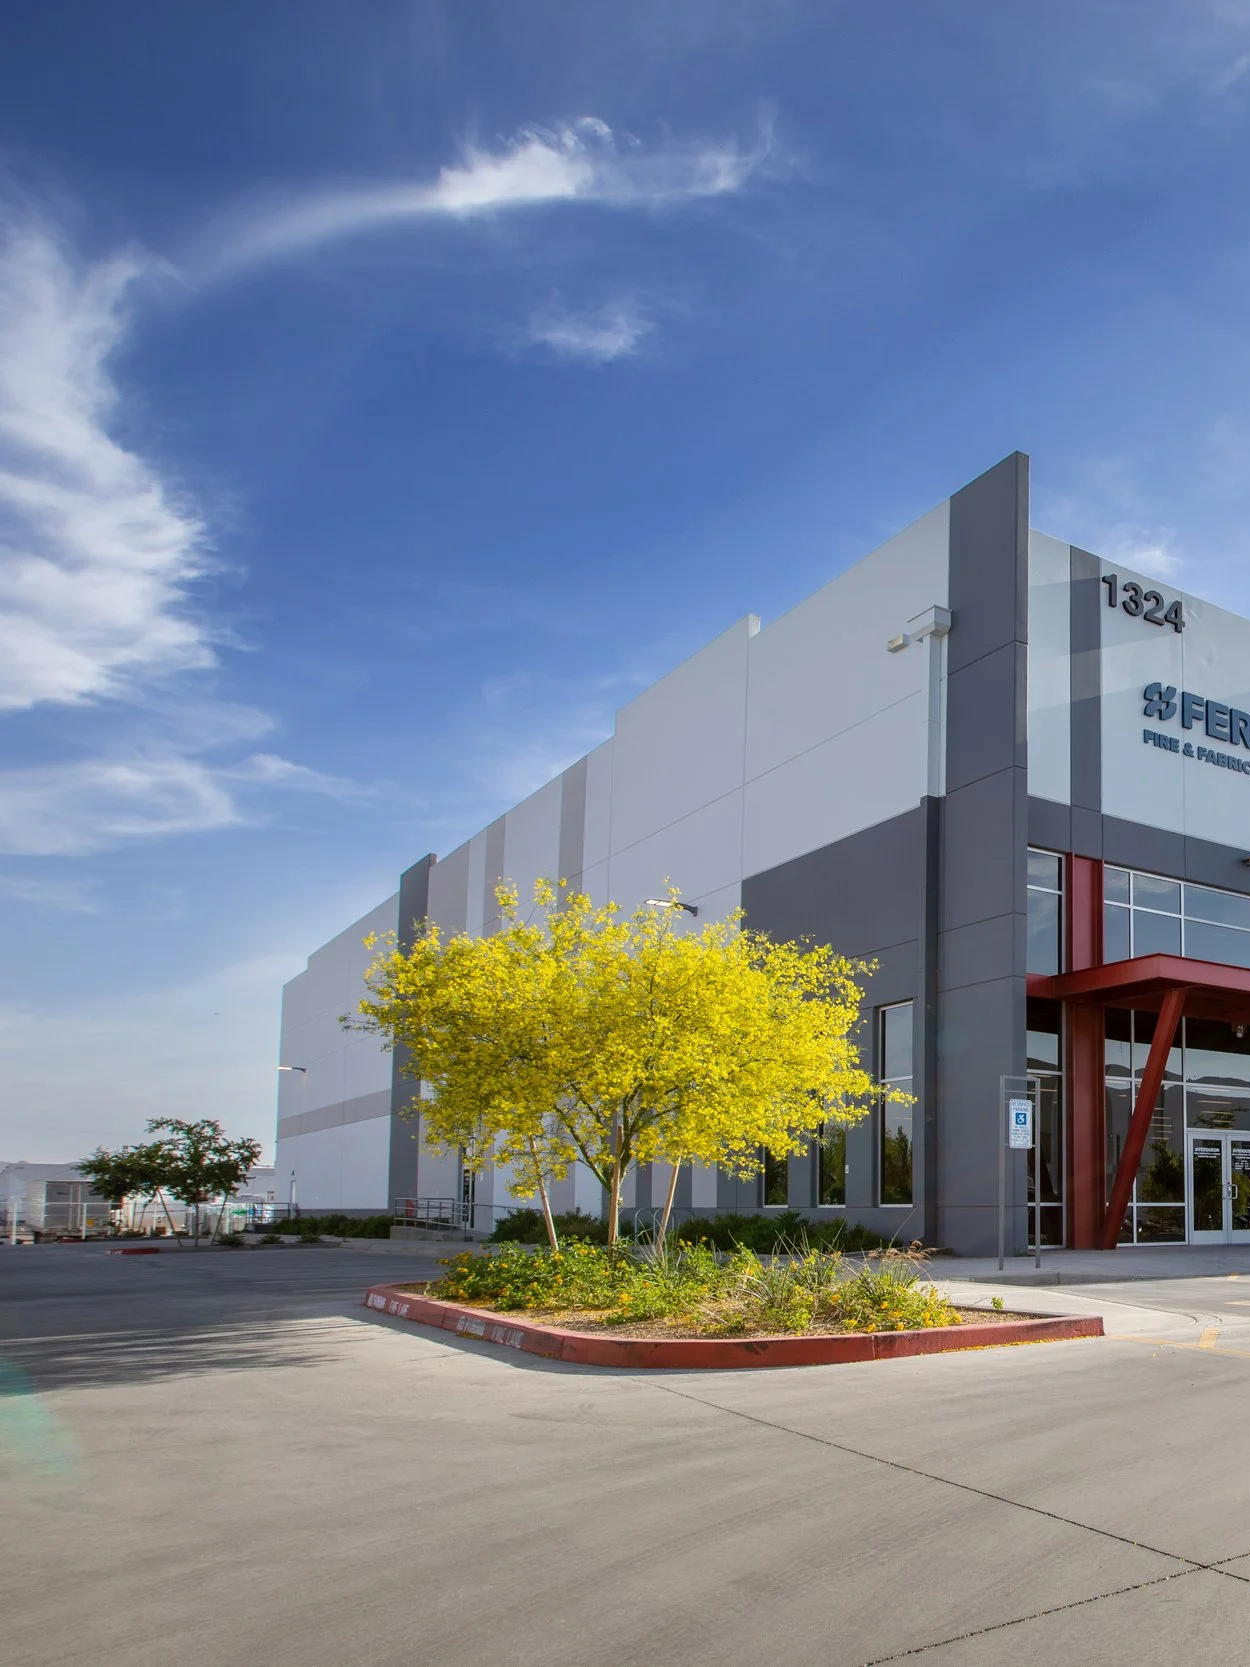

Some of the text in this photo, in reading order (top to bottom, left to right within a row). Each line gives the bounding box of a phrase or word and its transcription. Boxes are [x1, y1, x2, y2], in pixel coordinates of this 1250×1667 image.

[1102, 574, 1185, 633] 1324
[1143, 729, 1180, 754] FIRE
[1183, 742, 1194, 758] &
